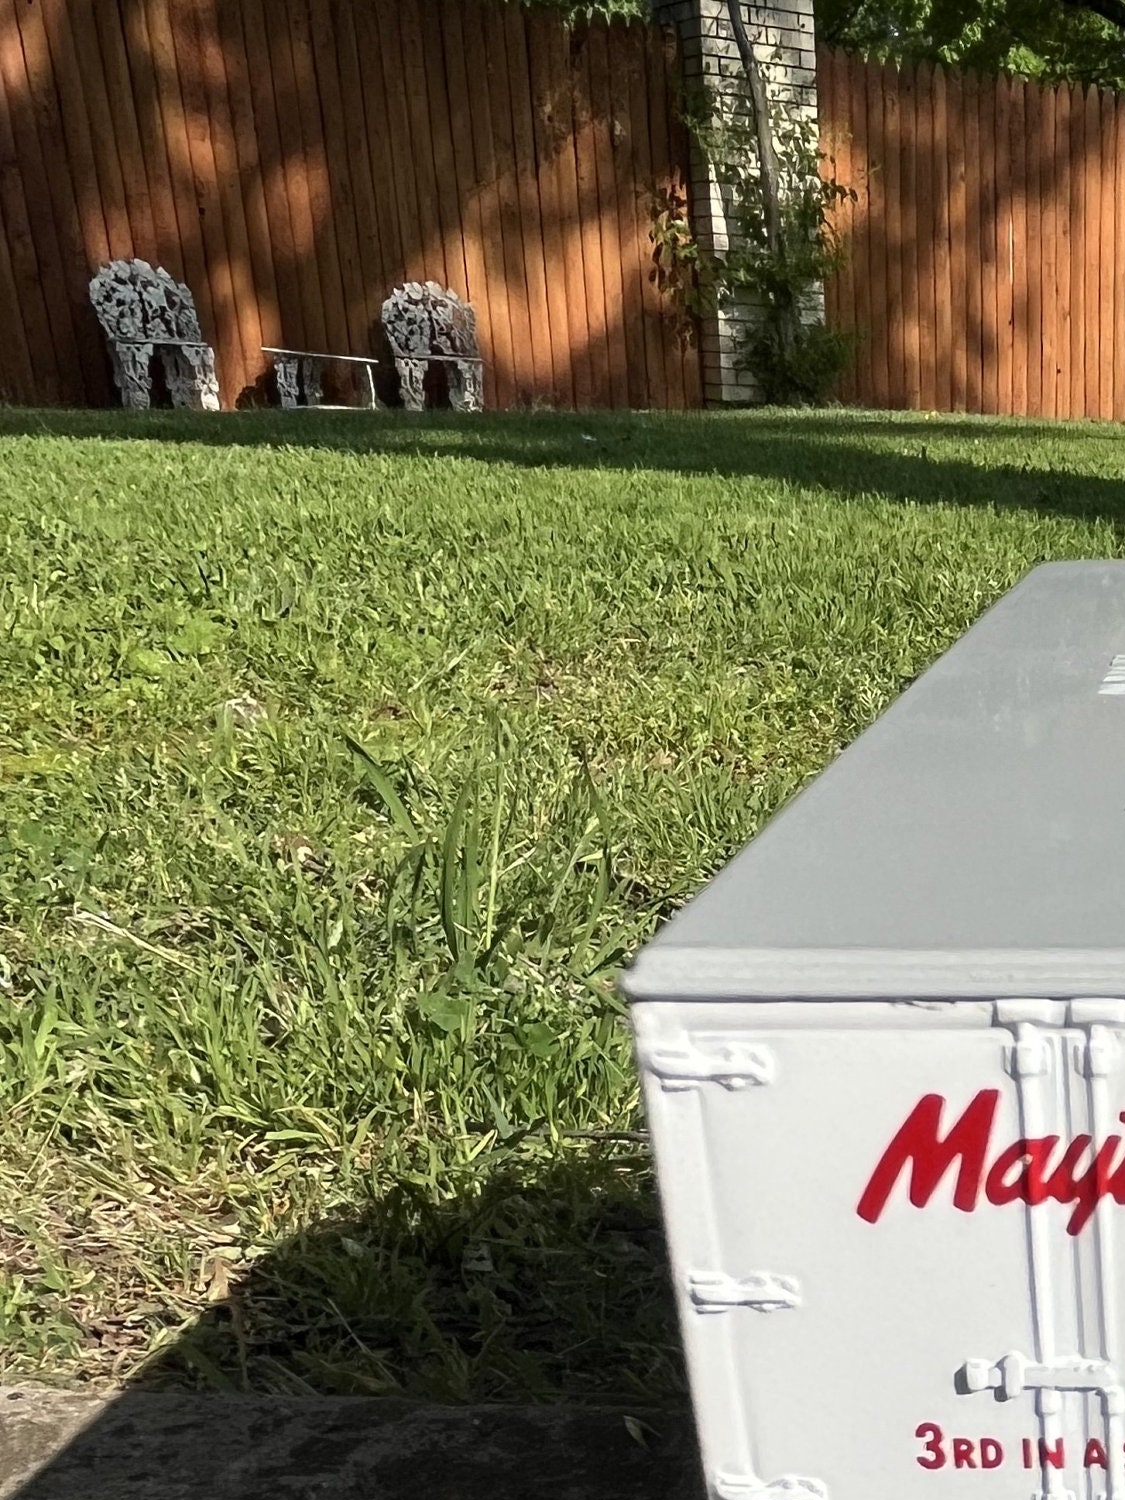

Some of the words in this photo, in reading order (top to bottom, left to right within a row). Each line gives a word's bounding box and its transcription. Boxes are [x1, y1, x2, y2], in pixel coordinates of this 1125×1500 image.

[914, 1422, 1004, 1470] 3RD
[1021, 1437, 1065, 1469] IN
[1083, 1437, 1109, 1470] A
